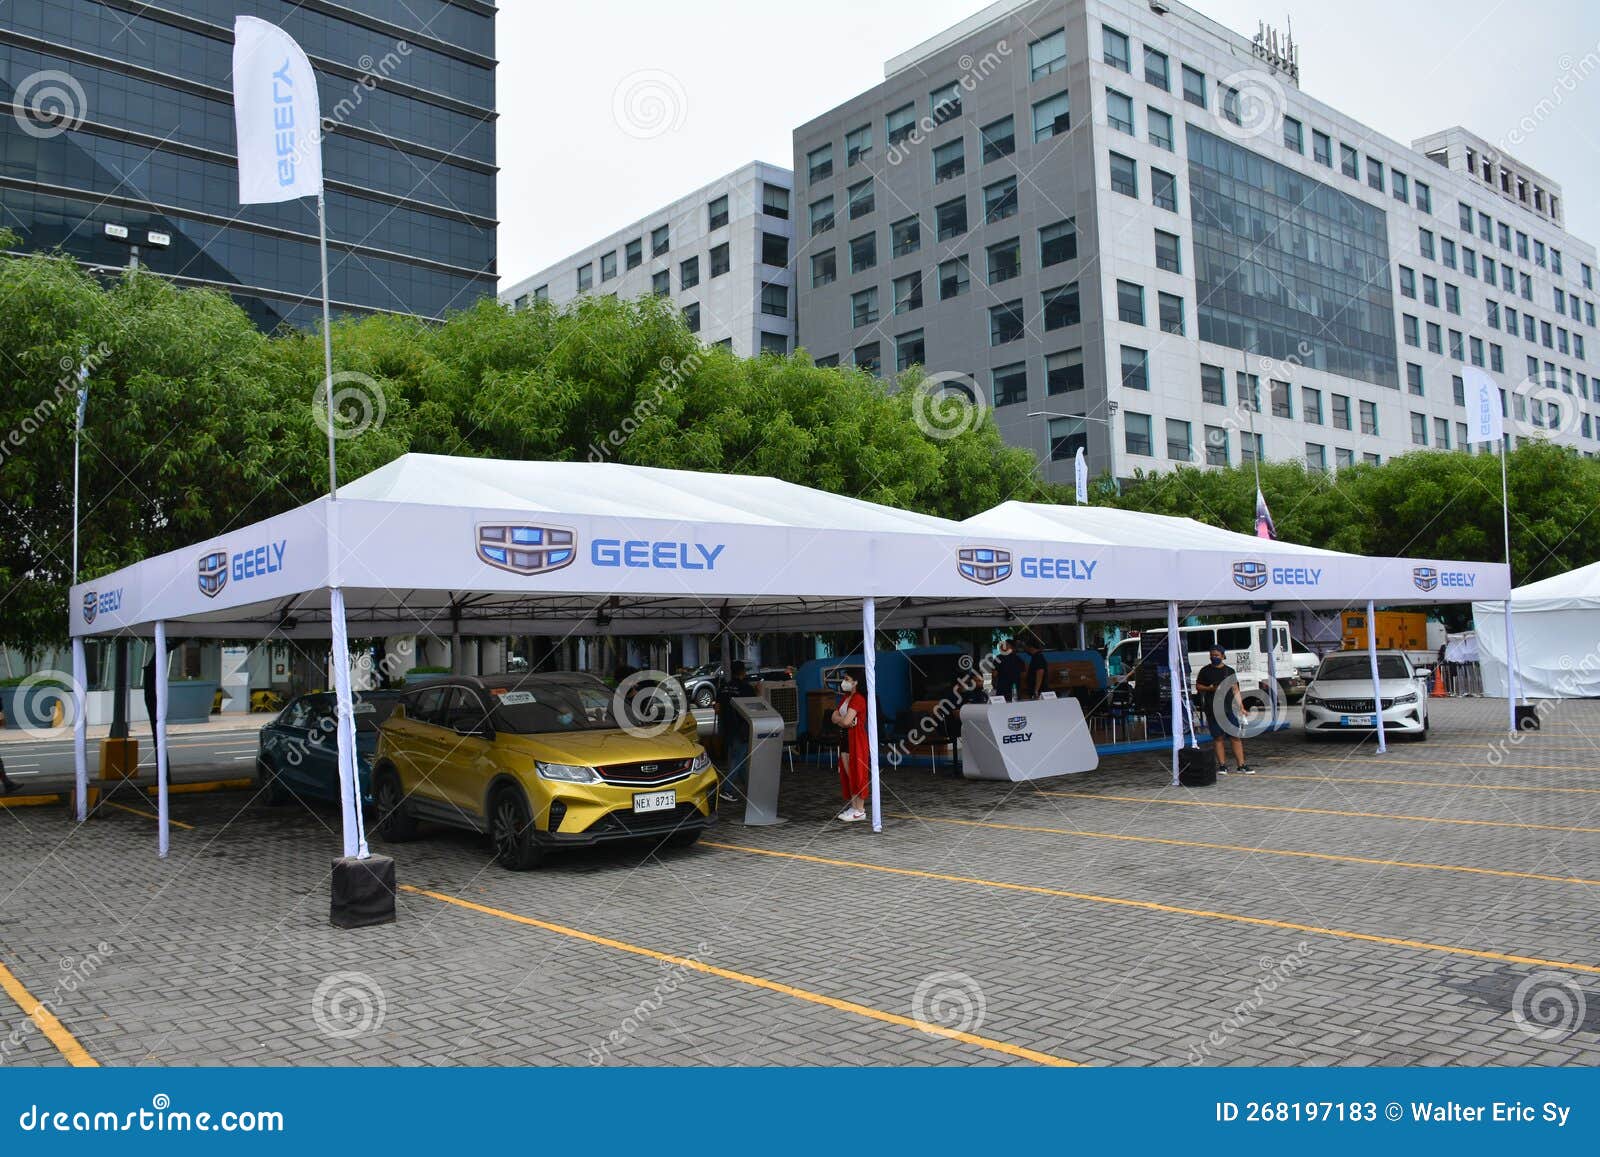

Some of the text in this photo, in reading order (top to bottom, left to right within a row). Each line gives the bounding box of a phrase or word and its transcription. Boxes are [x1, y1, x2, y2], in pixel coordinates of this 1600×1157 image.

[232, 540, 286, 580] GEELY
[591, 538, 725, 570] GEELY
[1020, 557, 1097, 580] GEELY
[1272, 567, 1322, 585] GEELY
[1440, 572, 1476, 588] GEELY
[99, 588, 123, 614] GEELY
[1002, 732, 1033, 745] GEELY
[636, 795, 674, 809] NEX 8713
